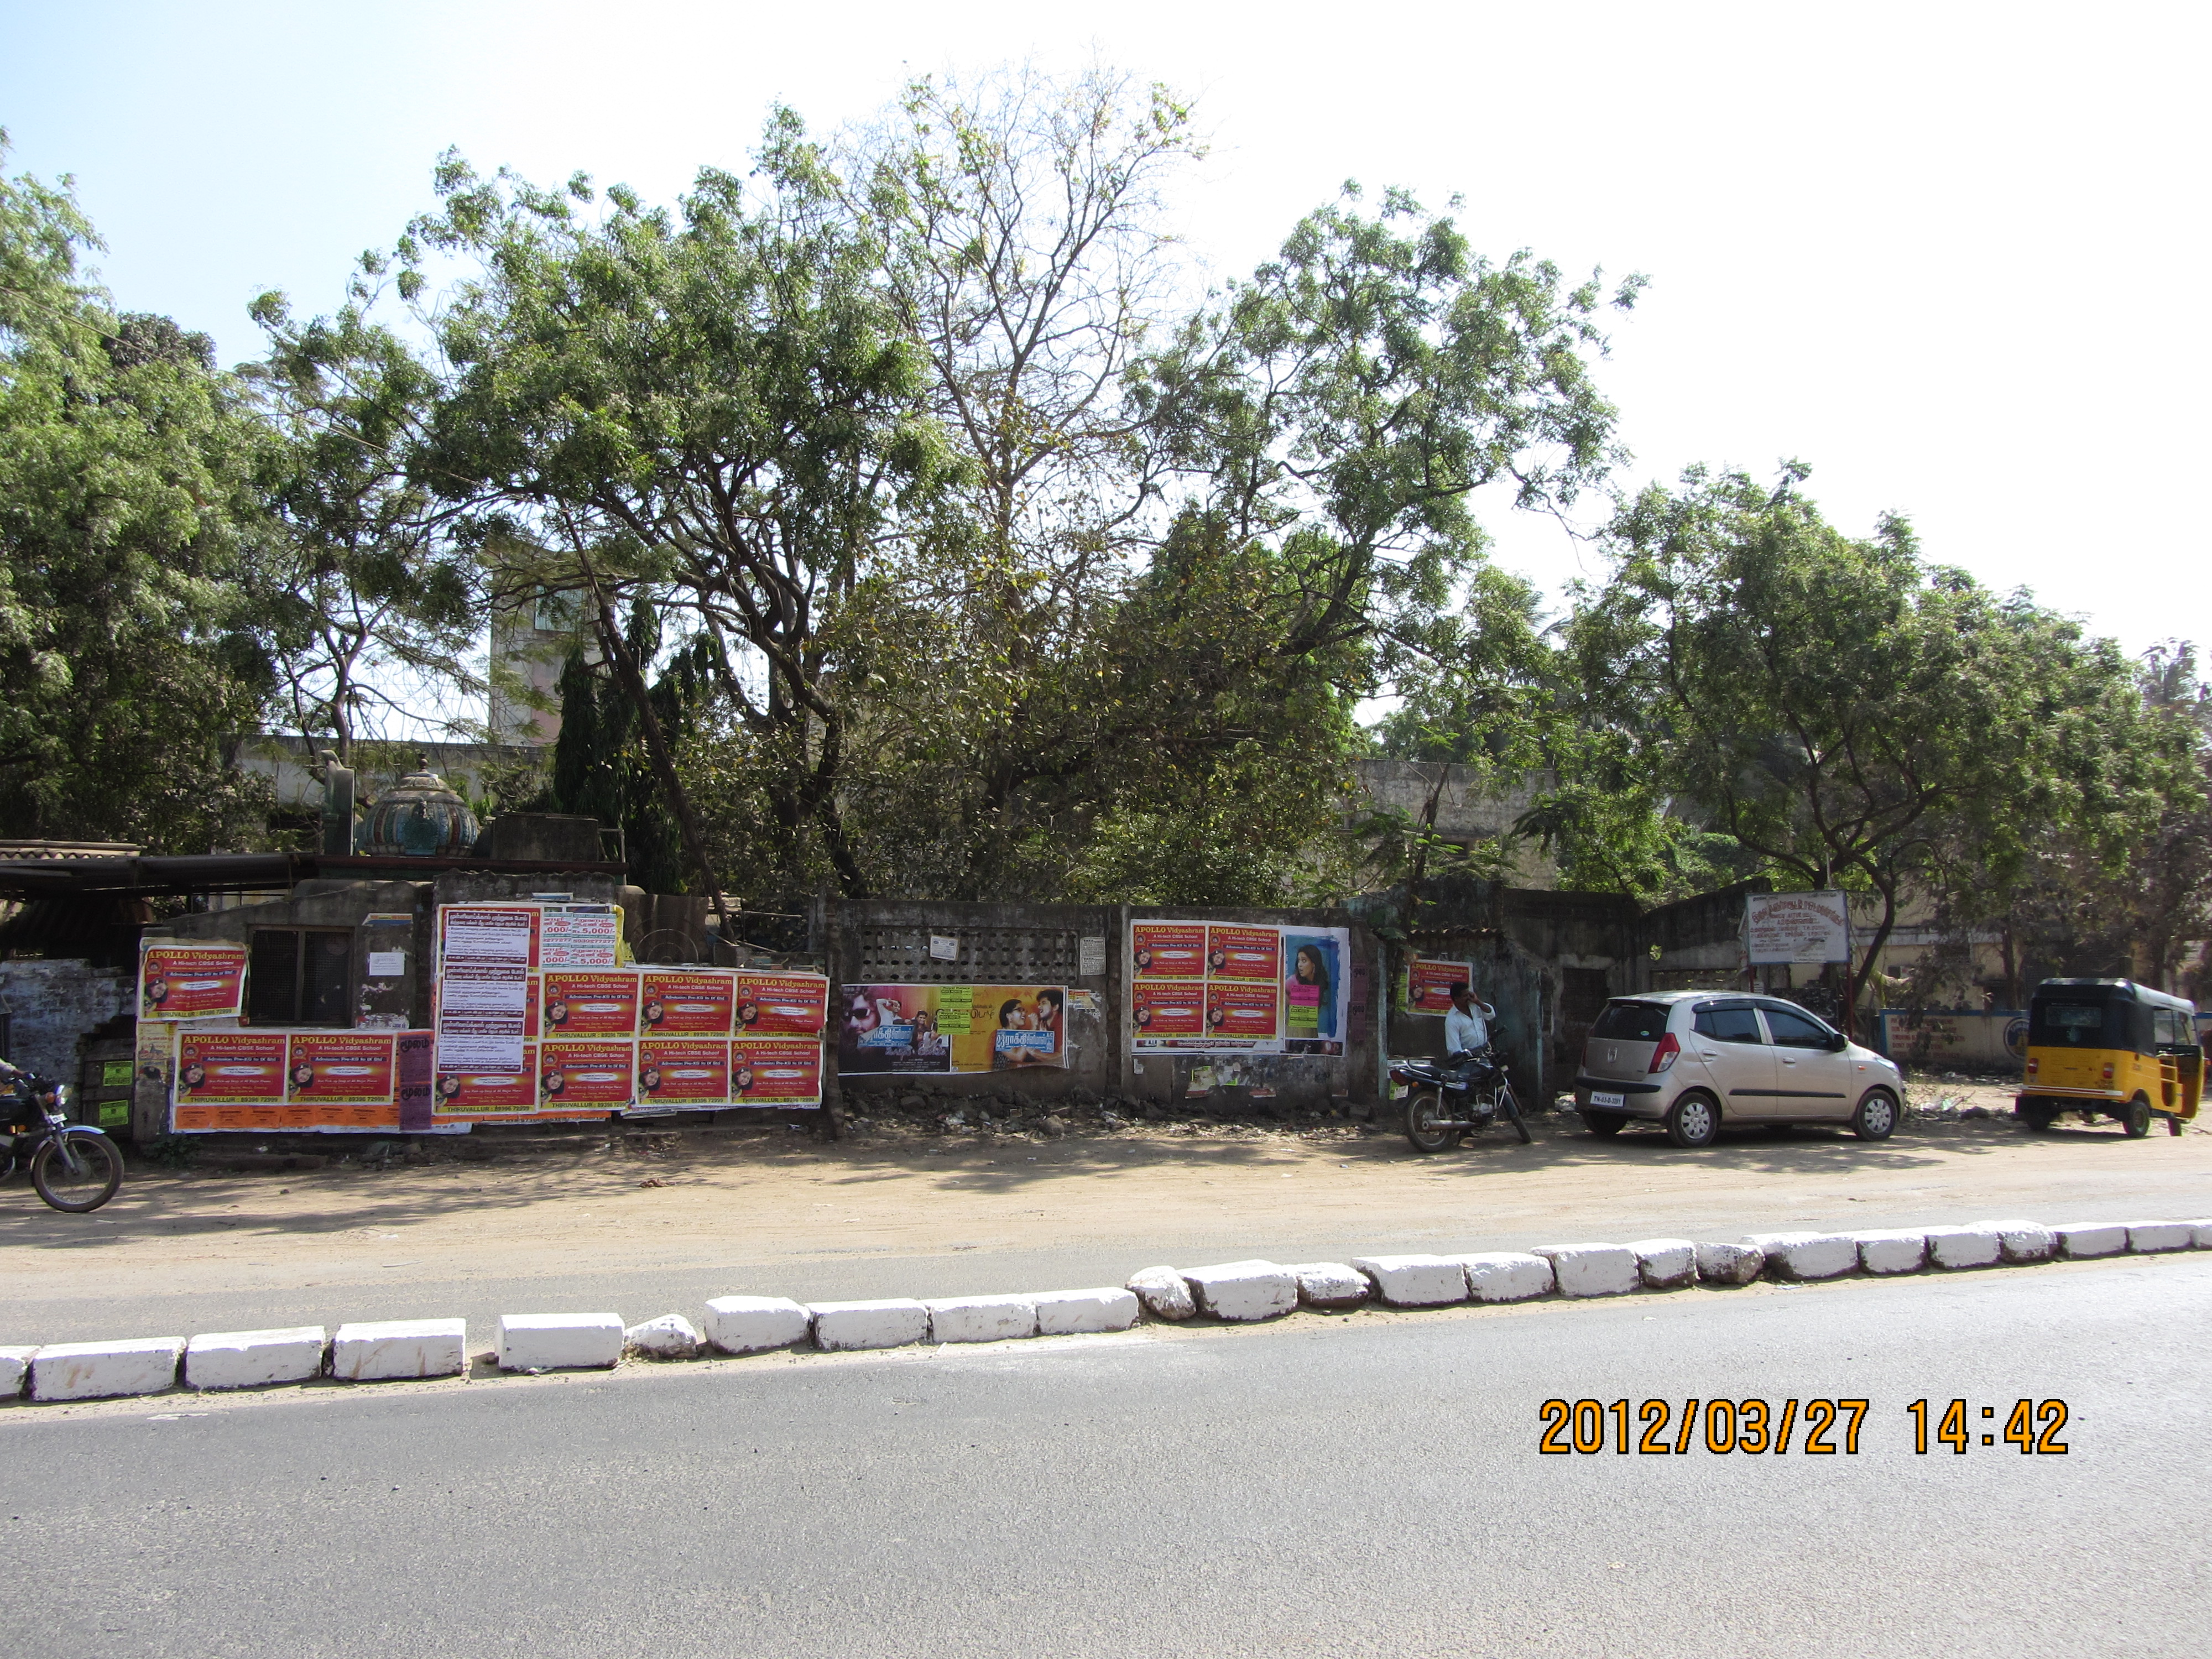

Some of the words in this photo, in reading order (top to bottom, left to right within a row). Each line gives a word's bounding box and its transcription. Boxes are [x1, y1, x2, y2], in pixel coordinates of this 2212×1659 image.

[591, 975, 637, 983] Vidyashram
[779, 980, 825, 988] Vidyashram
[231, 1036, 285, 1045] Vidyashram
